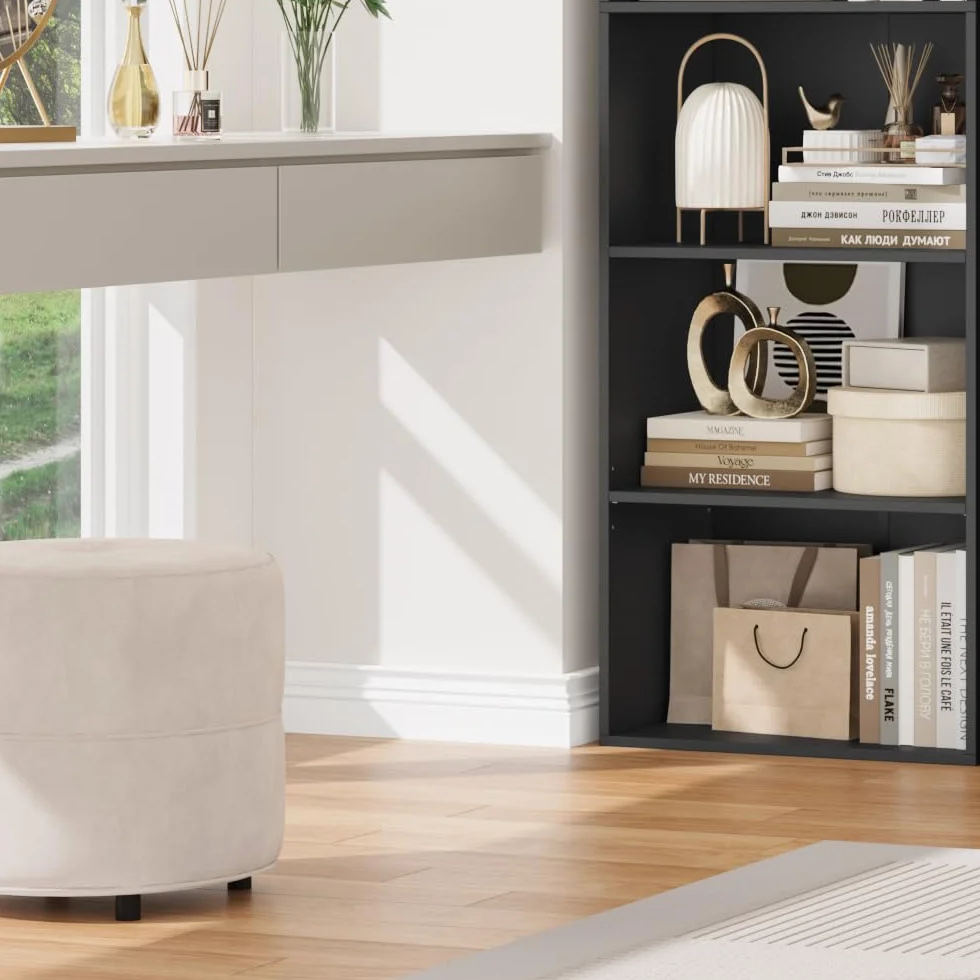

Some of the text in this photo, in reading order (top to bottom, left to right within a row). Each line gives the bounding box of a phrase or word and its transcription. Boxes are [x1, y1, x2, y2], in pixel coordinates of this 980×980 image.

[801, 209, 945, 224] ДЖОН ДЭВИСОН РОКФЕЛЛЕР
[841, 234, 862, 245] КАК
[865, 234, 898, 247] ЛЮДИ
[902, 235, 951, 247] ДУМАЮТ
[707, 425, 744, 436] MAGAZINE
[717, 455, 755, 469] Voyage
[688, 472, 771, 486] MY RESIDENCE
[941, 602, 952, 610] IL
[919, 609, 932, 624] НЕ
[941, 612, 954, 635] ÉTAIT
[919, 626, 932, 658] БЕРИ
[941, 637, 952, 655] UNE
[865, 605, 877, 701] amanda lovelace
[941, 657, 952, 675] FOIS
[941, 677, 952, 688] LE
[919, 672, 932, 721] ГОЛОВУ
[884, 687, 895, 722] FLAKE
